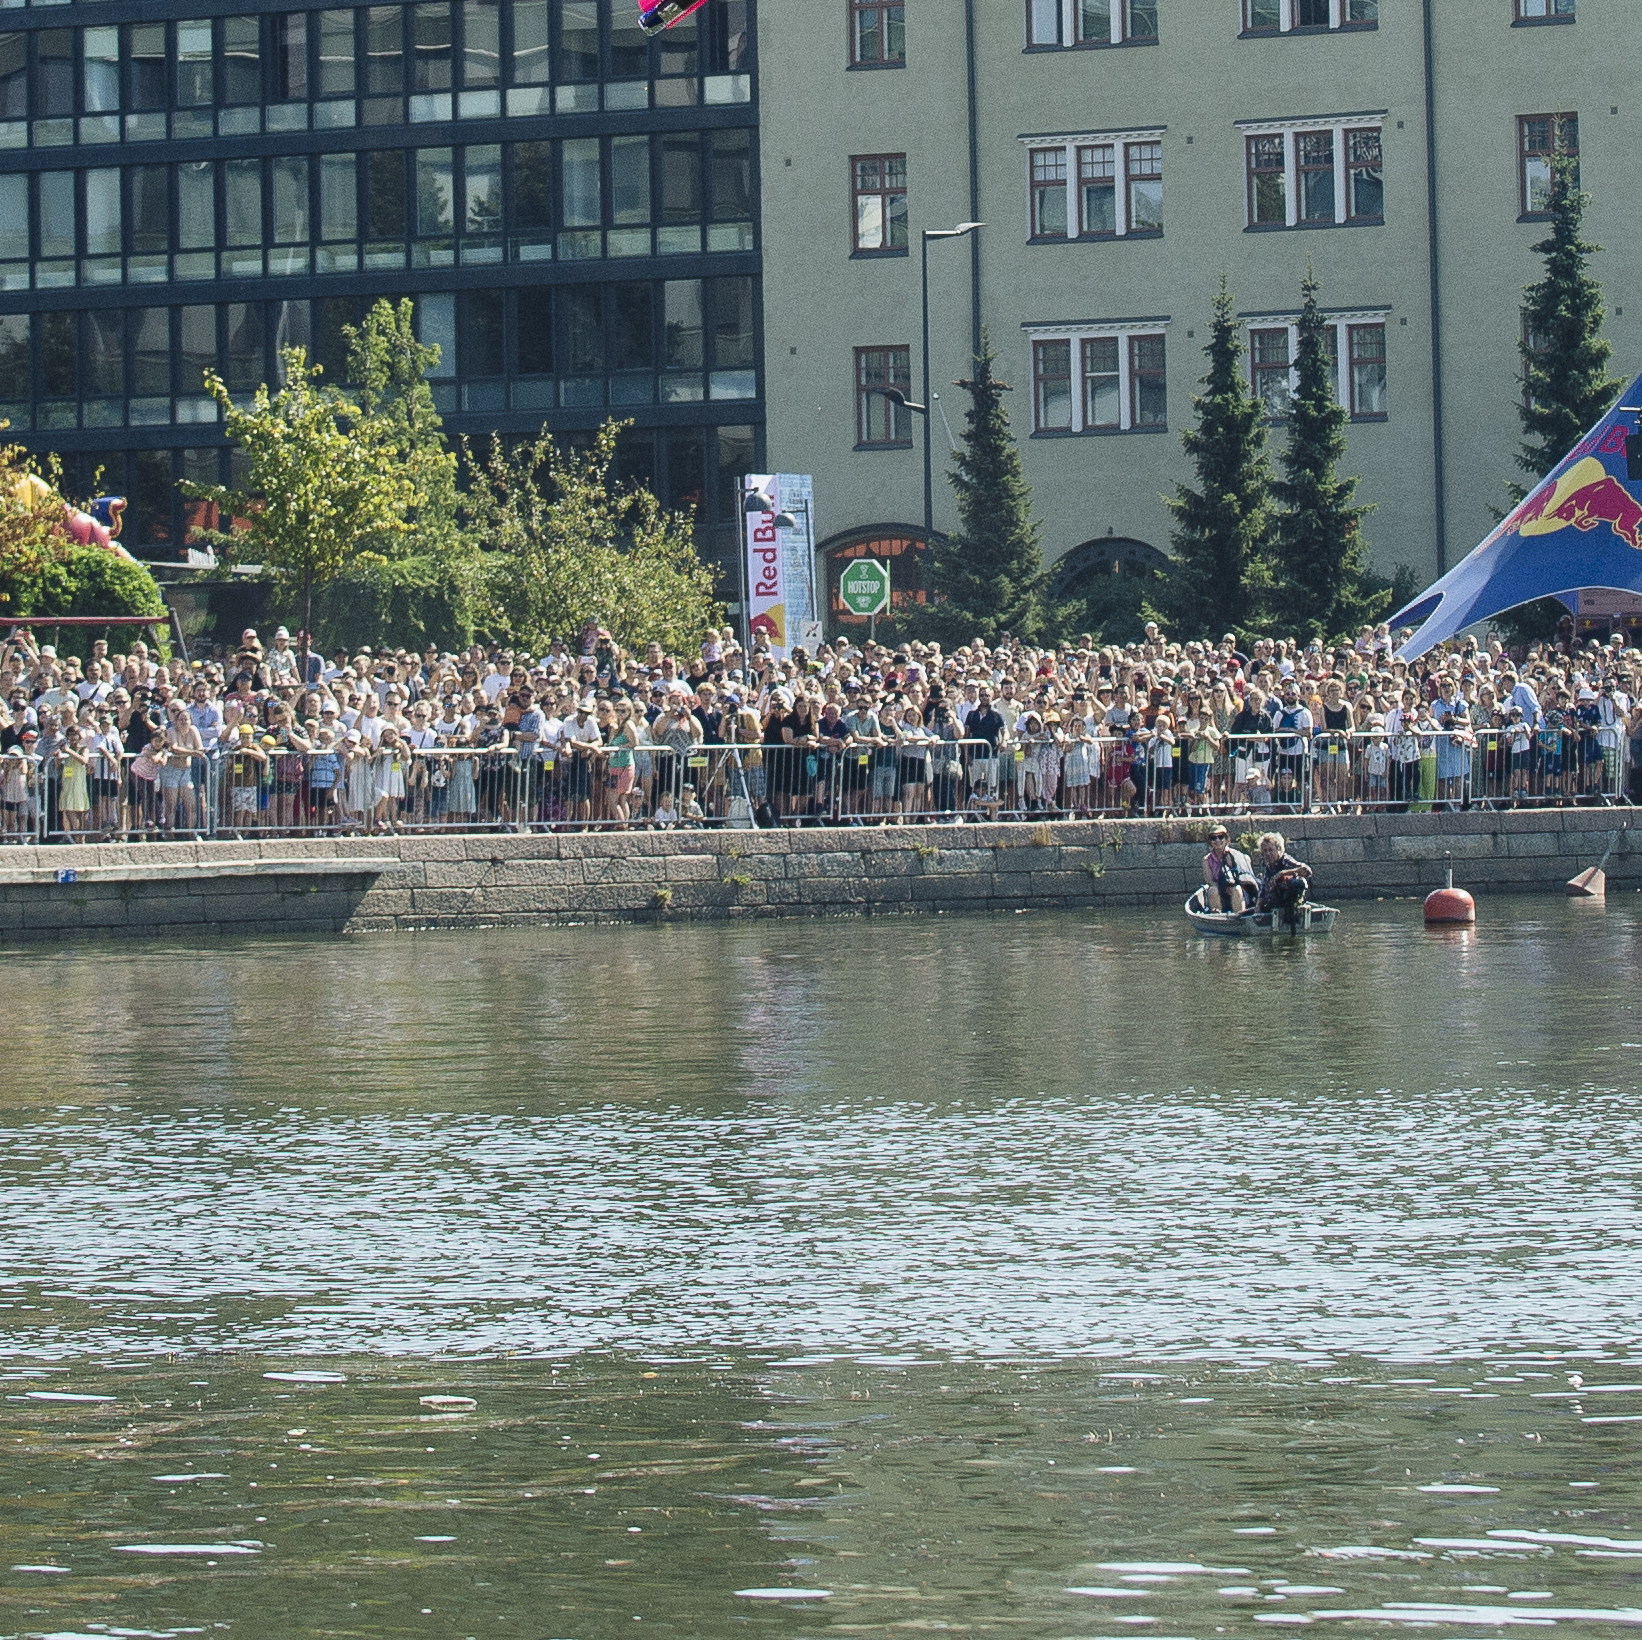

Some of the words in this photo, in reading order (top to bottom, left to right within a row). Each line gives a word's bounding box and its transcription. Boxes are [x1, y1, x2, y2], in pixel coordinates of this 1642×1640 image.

[753, 495, 777, 543] Bu
[753, 548, 778, 597] Red
[847, 580, 881, 594] HOTSTOP
